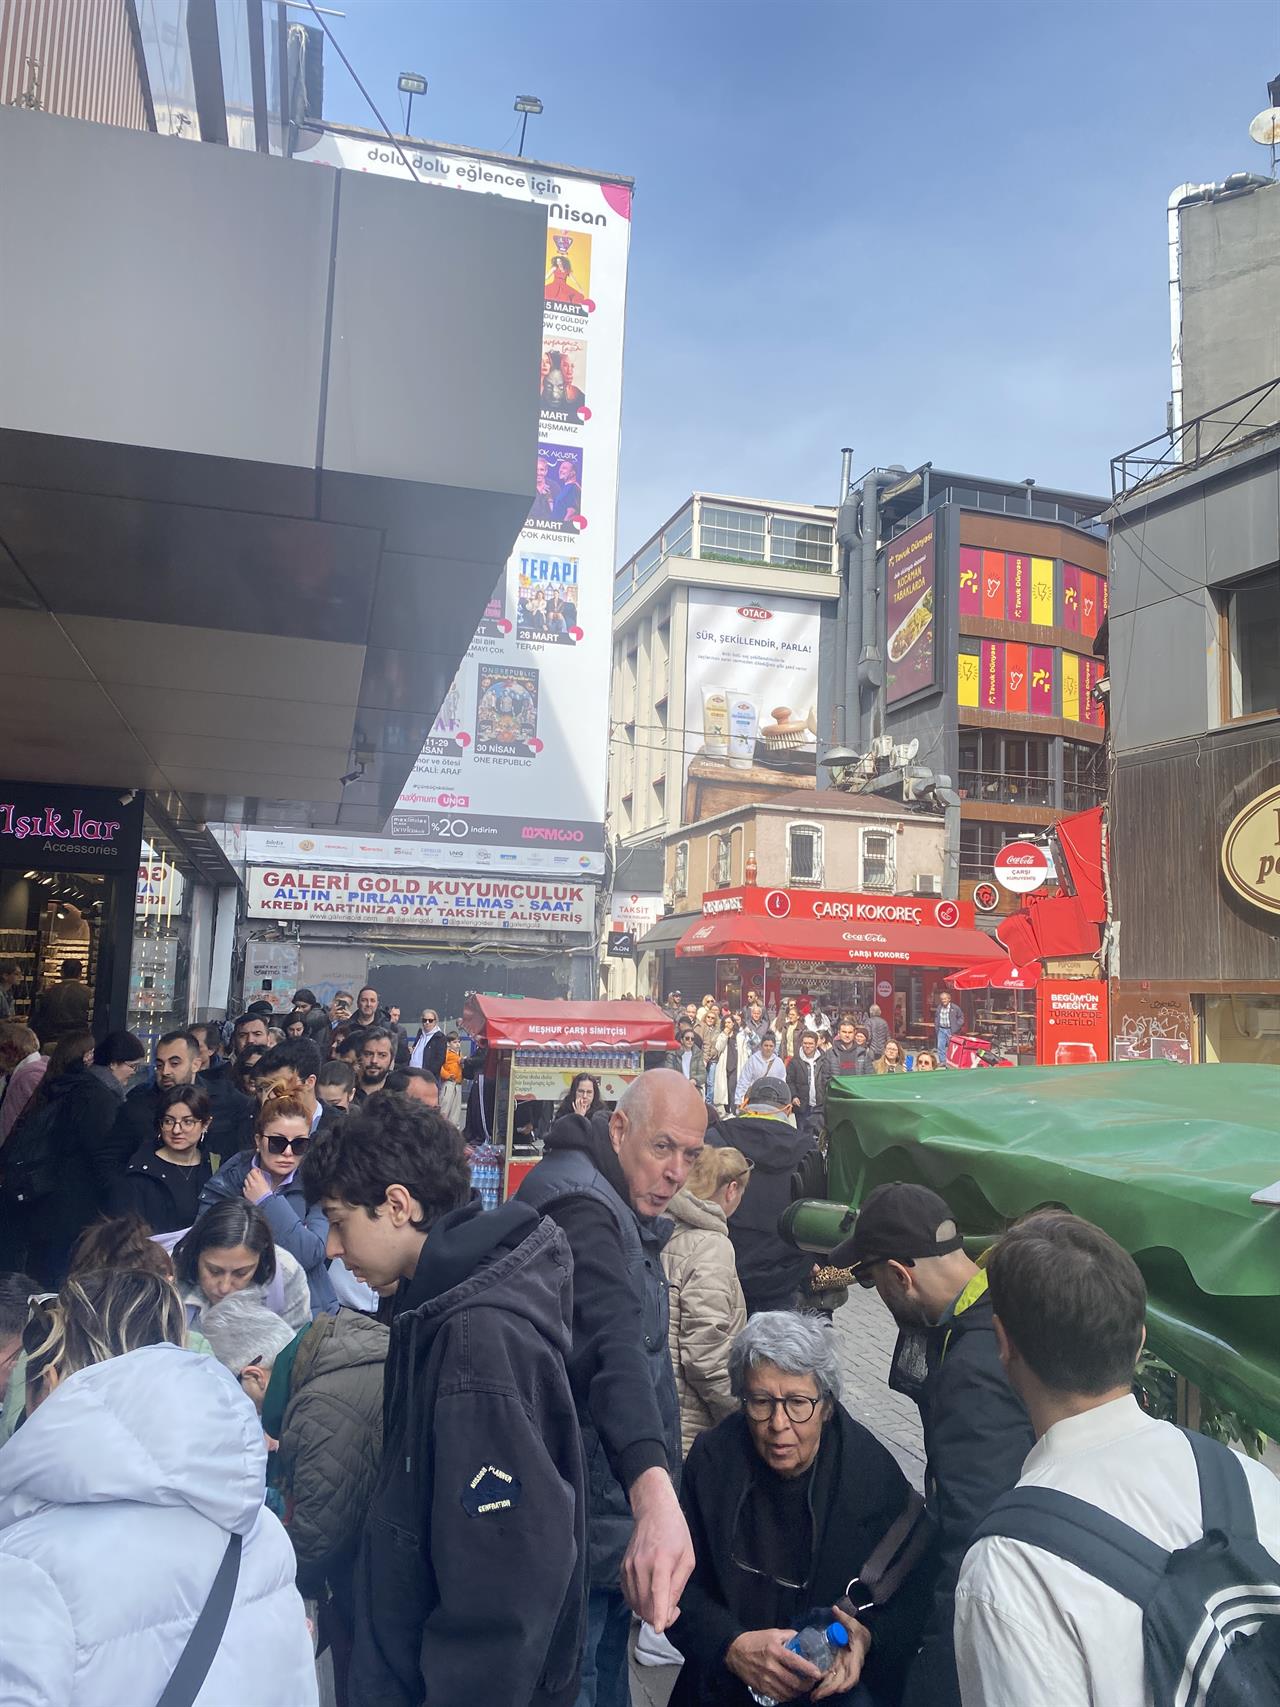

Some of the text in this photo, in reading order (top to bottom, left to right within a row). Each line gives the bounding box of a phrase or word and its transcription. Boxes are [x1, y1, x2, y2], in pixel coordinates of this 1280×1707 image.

[367, 147, 561, 195] dolu dolu eğlence için
[553, 303, 582, 315] MART
[555, 323, 584, 334] ÇOCUK
[541, 410, 569, 421] MART
[536, 520, 563, 531] MART
[520, 531, 576, 543] ÇOK AKUSTİK
[894, 546, 911, 563] Tavuk
[910, 532, 933, 553] Dünyası
[520, 557, 577, 583] TERAPİ
[742, 608, 767, 620] OTACI
[520, 631, 559, 642] 26 MART
[696, 630, 812, 653] SÜR, ŞEKİLLENDİR, PARLA!
[489, 646, 505, 654] ÇOK
[515, 642, 545, 652] TERAPİ
[421, 745, 444, 754] İSAN
[476, 744, 516, 754] 30 NİSAN
[492, 758, 532, 767] REPUBLIC
[440, 767, 462, 775] ARAF
[0, 803, 121, 842] Işıklar
[470, 825, 498, 834] indirim
[43, 840, 118, 856] Accessories
[263, 871, 584, 901] GALERİ GOLD KUYUMCULUK
[274, 888, 330, 901] ALTIN
[348, 892, 439, 906] PIRLANTA
[454, 896, 514, 909] ELMAS
[529, 900, 574, 912] SAAT
[630, 895, 639, 905] 9
[260, 900, 583, 925] KREDİ KARTINIZA 9 AY TAKSİTLE ALIŞVERİŞ
[619, 905, 649, 914] TAKSİT
[812, 901, 922, 925] ÇARŞI KOKOREÇ
[848, 950, 910, 960] ÇARŞI KOKOREÇ
[1050, 992, 1099, 1003] BEGÜM'ÜN
[1052, 1001, 1098, 1011] EMEĞİYLE
[528, 1025, 627, 1036] MEŞHUR ÇARŞI SİMİTÇİSİ
